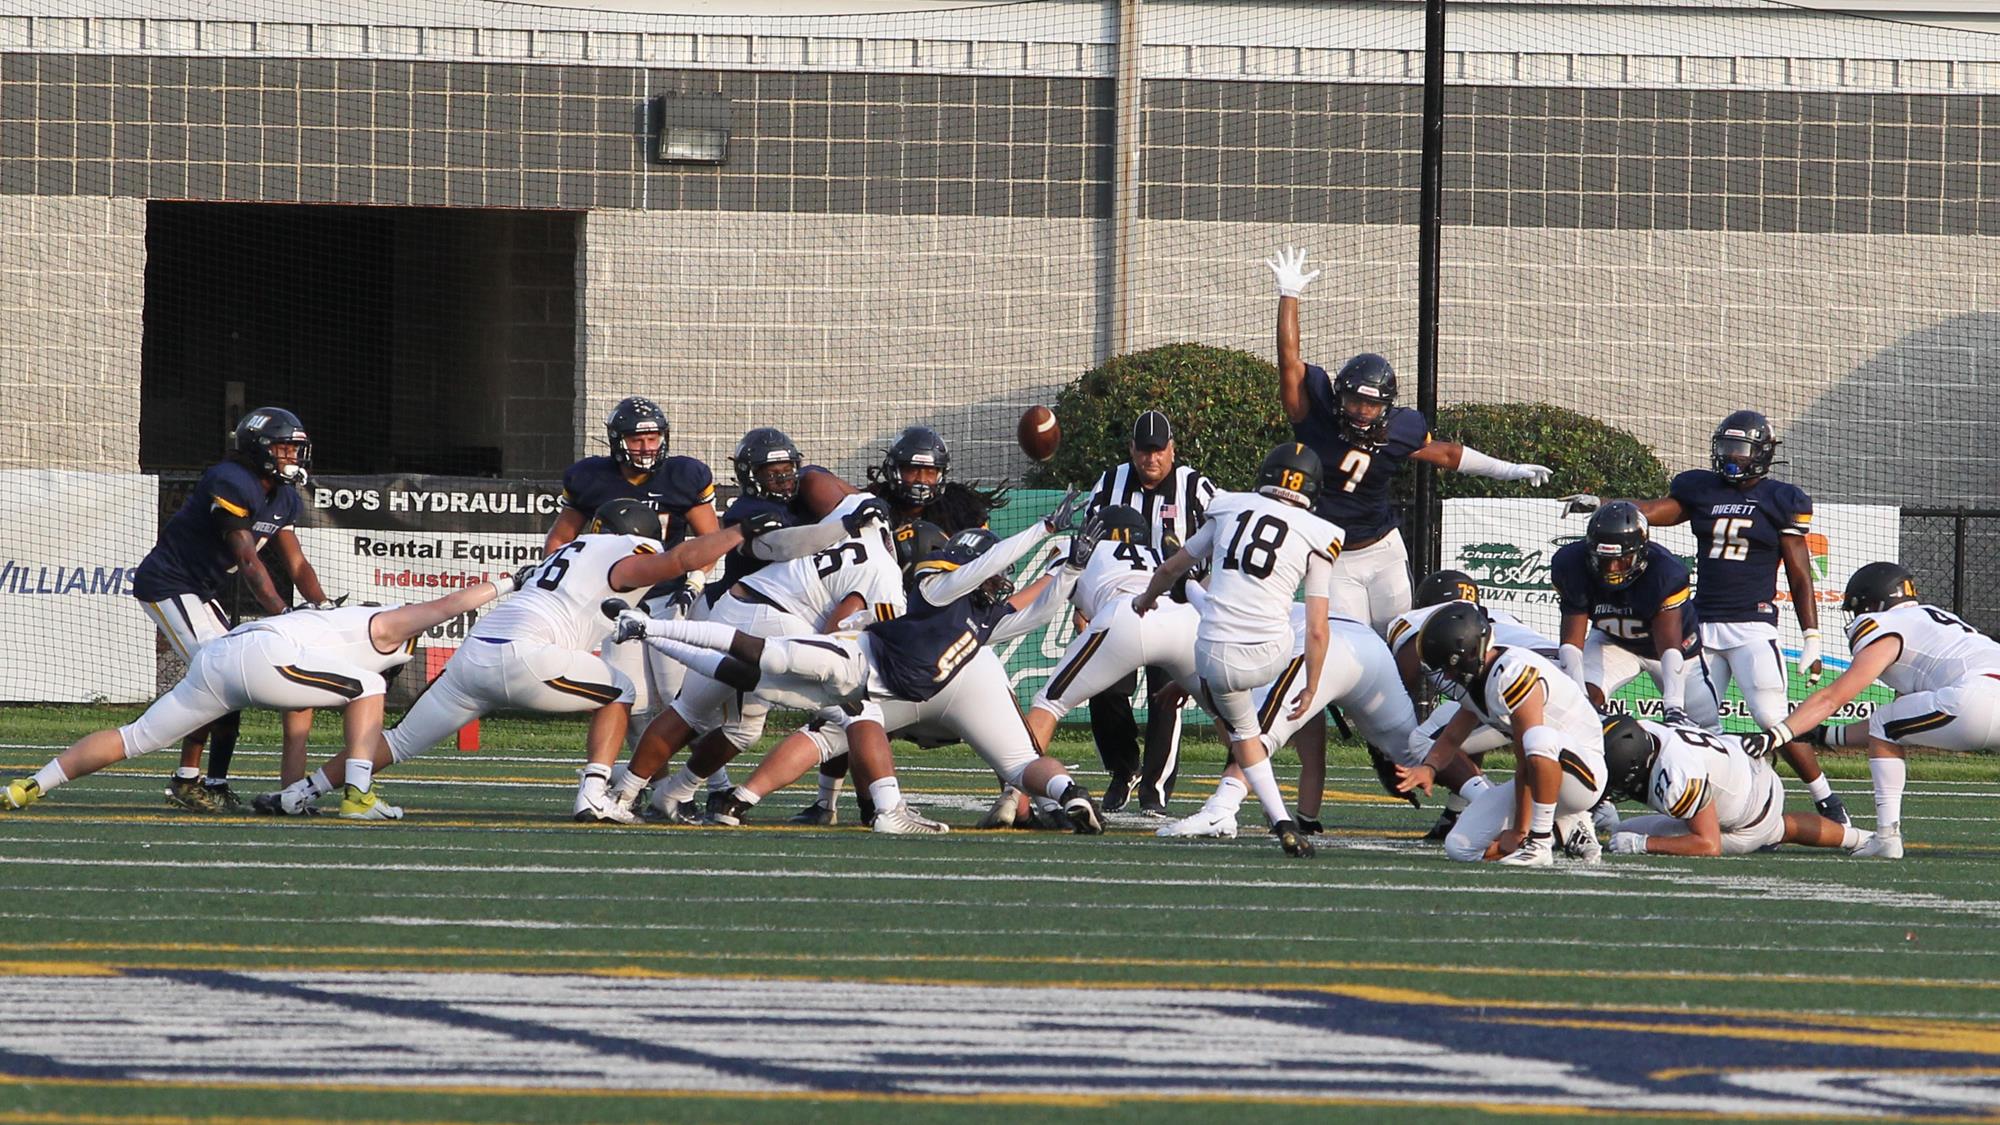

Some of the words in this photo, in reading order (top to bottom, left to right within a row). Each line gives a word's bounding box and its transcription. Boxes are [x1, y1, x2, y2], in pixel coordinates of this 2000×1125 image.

[1280, 469, 1304, 491] 18
[314, 488, 380, 511] BO'S
[1711, 503, 1756, 516] AVERETT
[354, 536, 442, 559] Rental
[1222, 509, 1290, 580] 18
[1708, 517, 1753, 562] 15
[1463, 550, 1522, 560] Charles
[374, 568, 489, 589] Industrial
